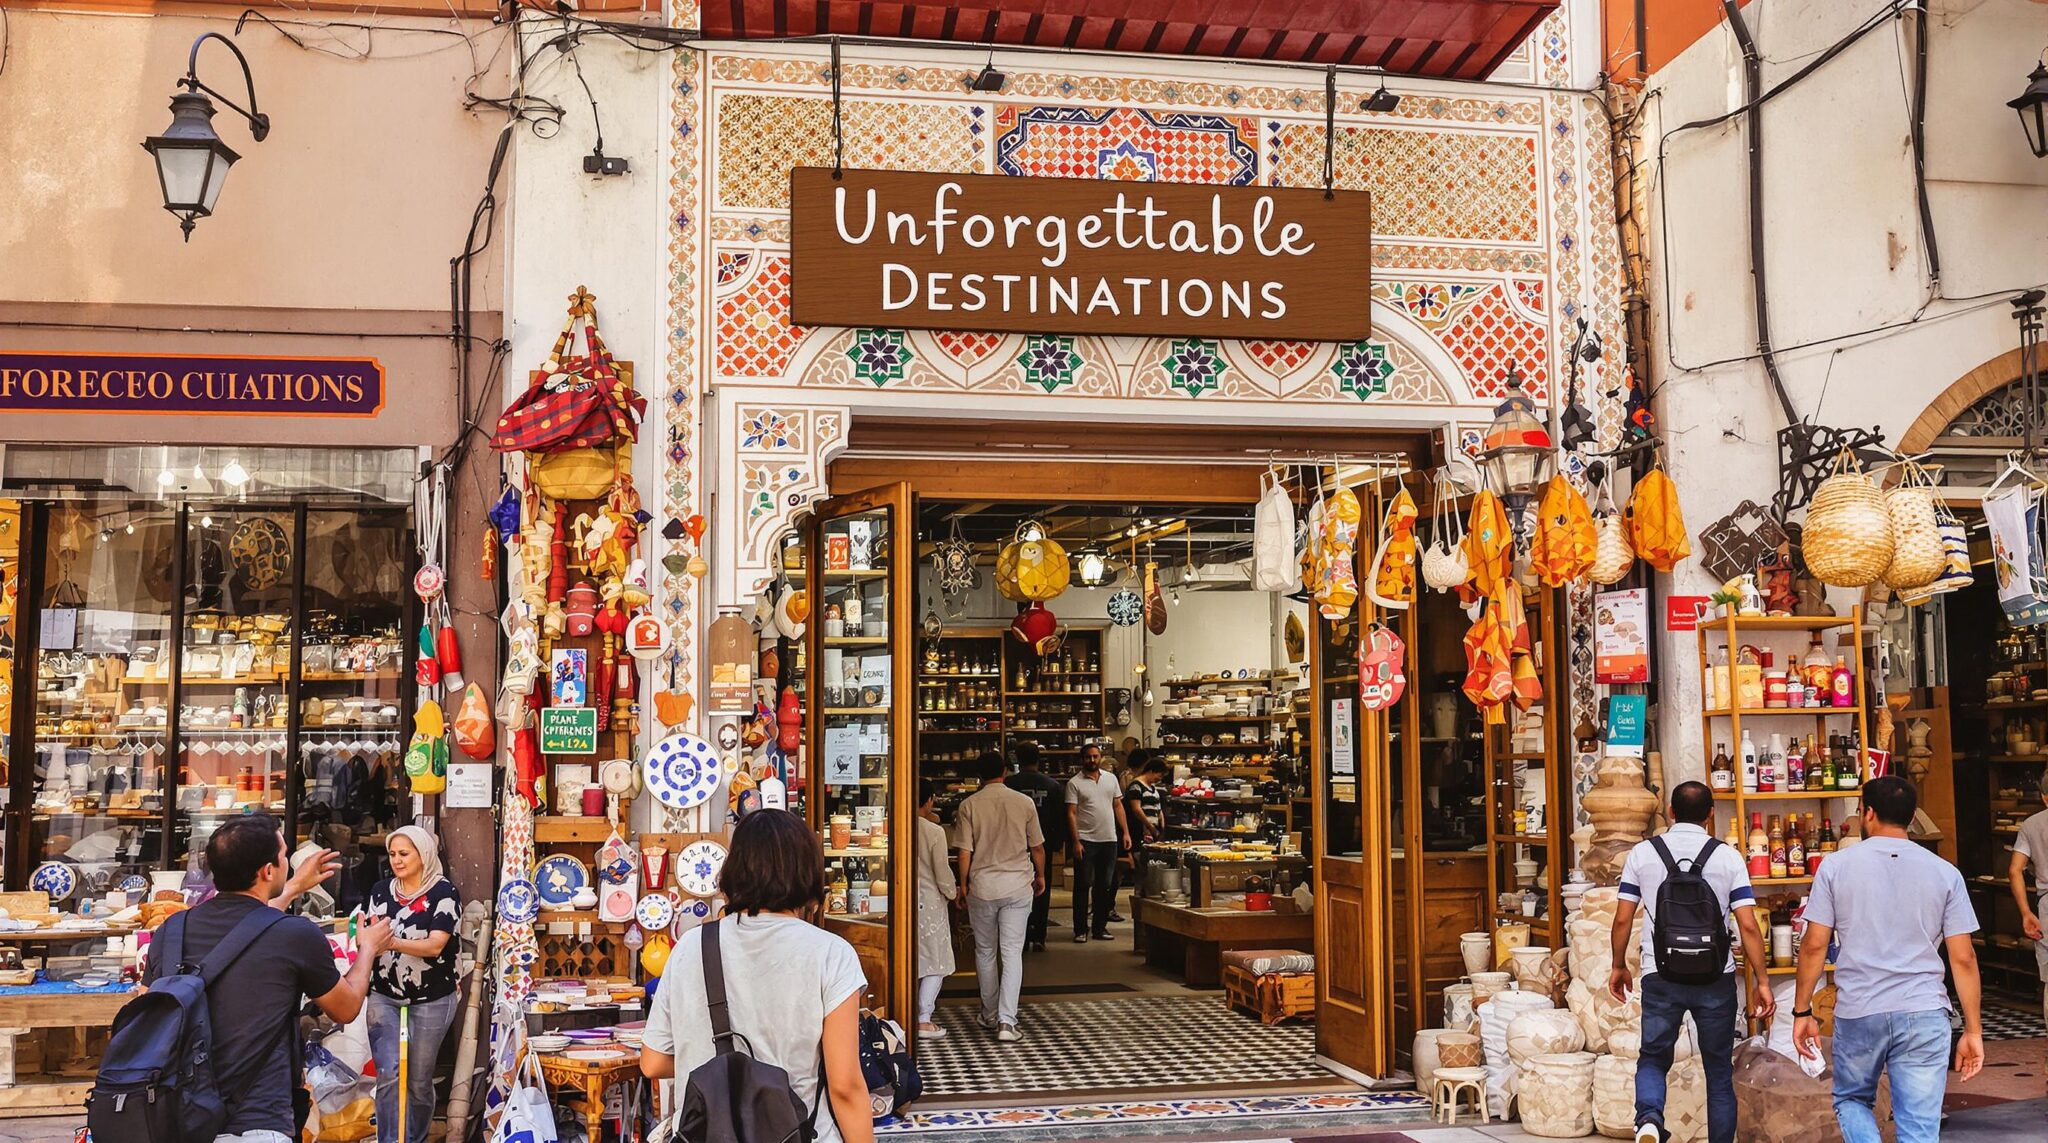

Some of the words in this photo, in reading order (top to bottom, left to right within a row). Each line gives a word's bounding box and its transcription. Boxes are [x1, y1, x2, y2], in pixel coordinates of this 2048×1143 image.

[835, 182, 1316, 268] Unforgettable
[882, 262, 1287, 320] DESTINATIONS
[0, 368, 174, 400] FORECEO
